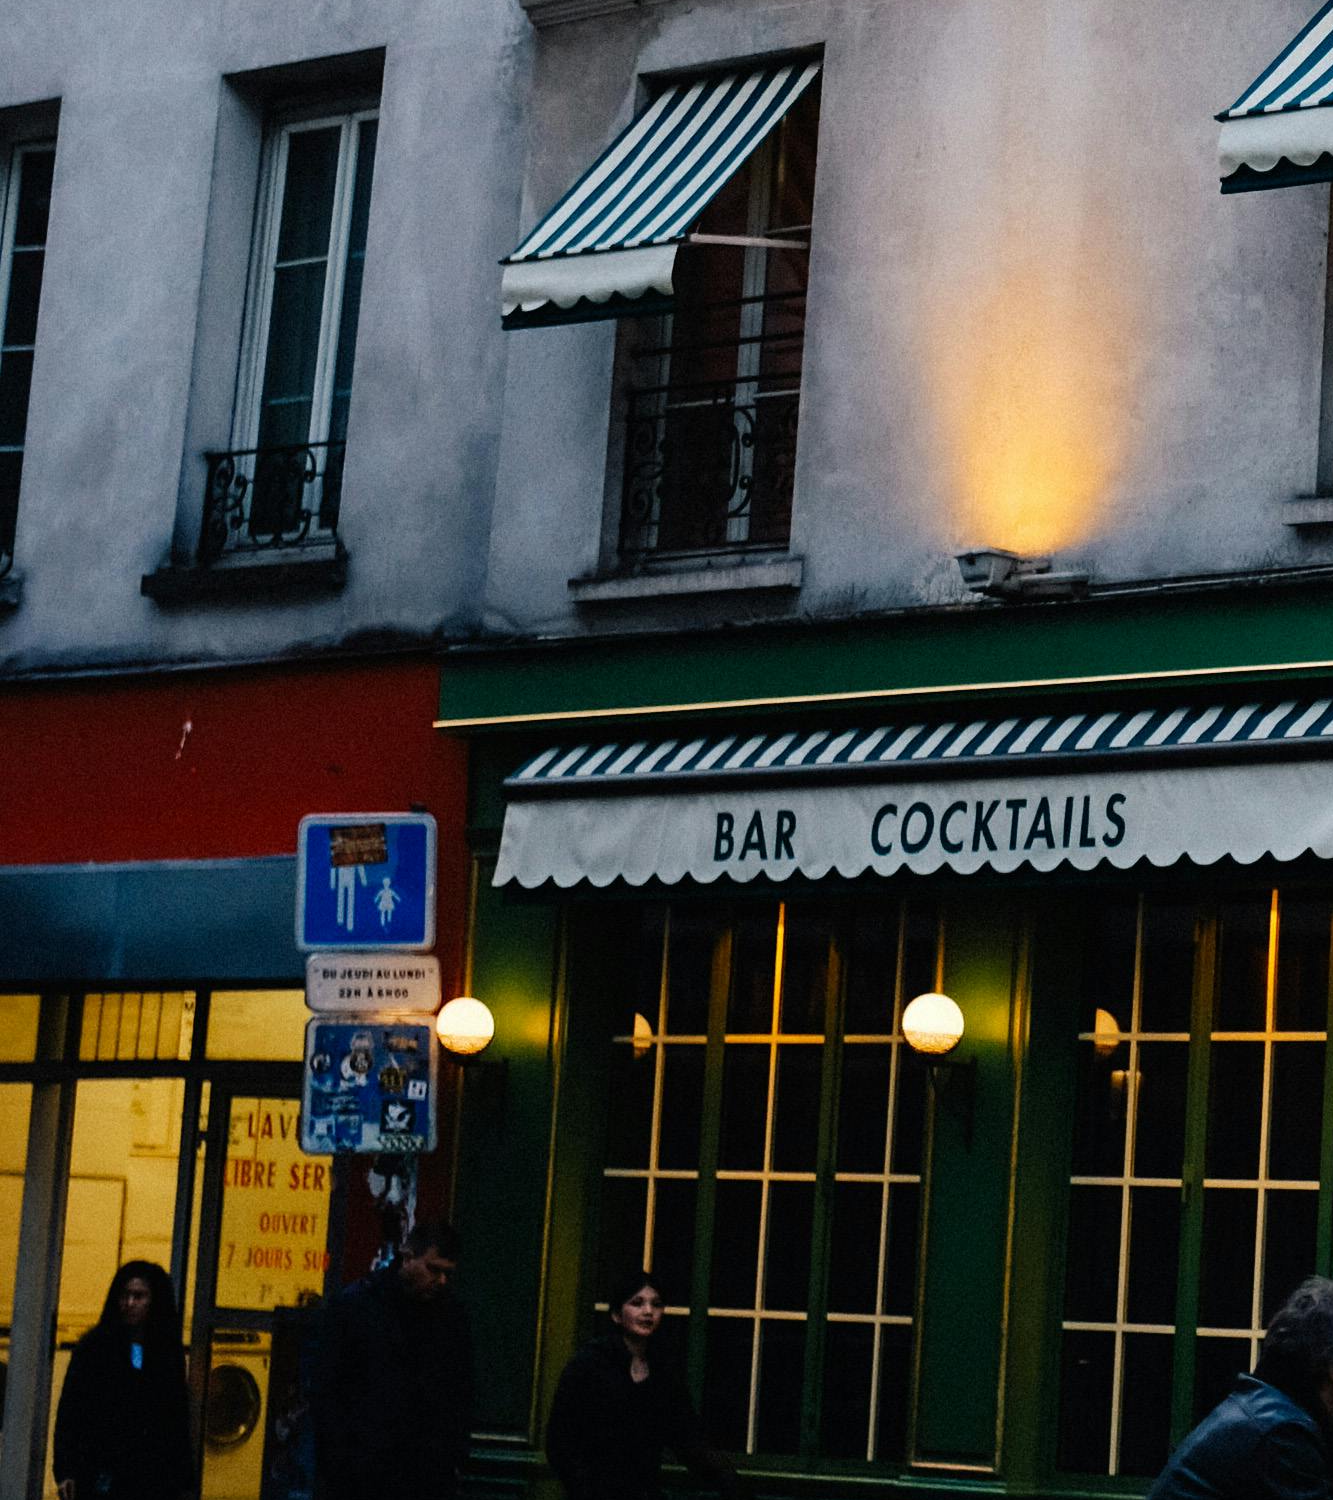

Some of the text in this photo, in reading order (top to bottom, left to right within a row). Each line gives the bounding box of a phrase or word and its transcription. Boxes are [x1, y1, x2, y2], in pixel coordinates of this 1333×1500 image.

[713, 793, 1128, 862] BAR COCKTAILS
[322, 969, 426, 979] DU JEUDI AU LUNDI
[259, 1212, 318, 1236] OUVERT
[245, 1247, 293, 1272] JOURS
